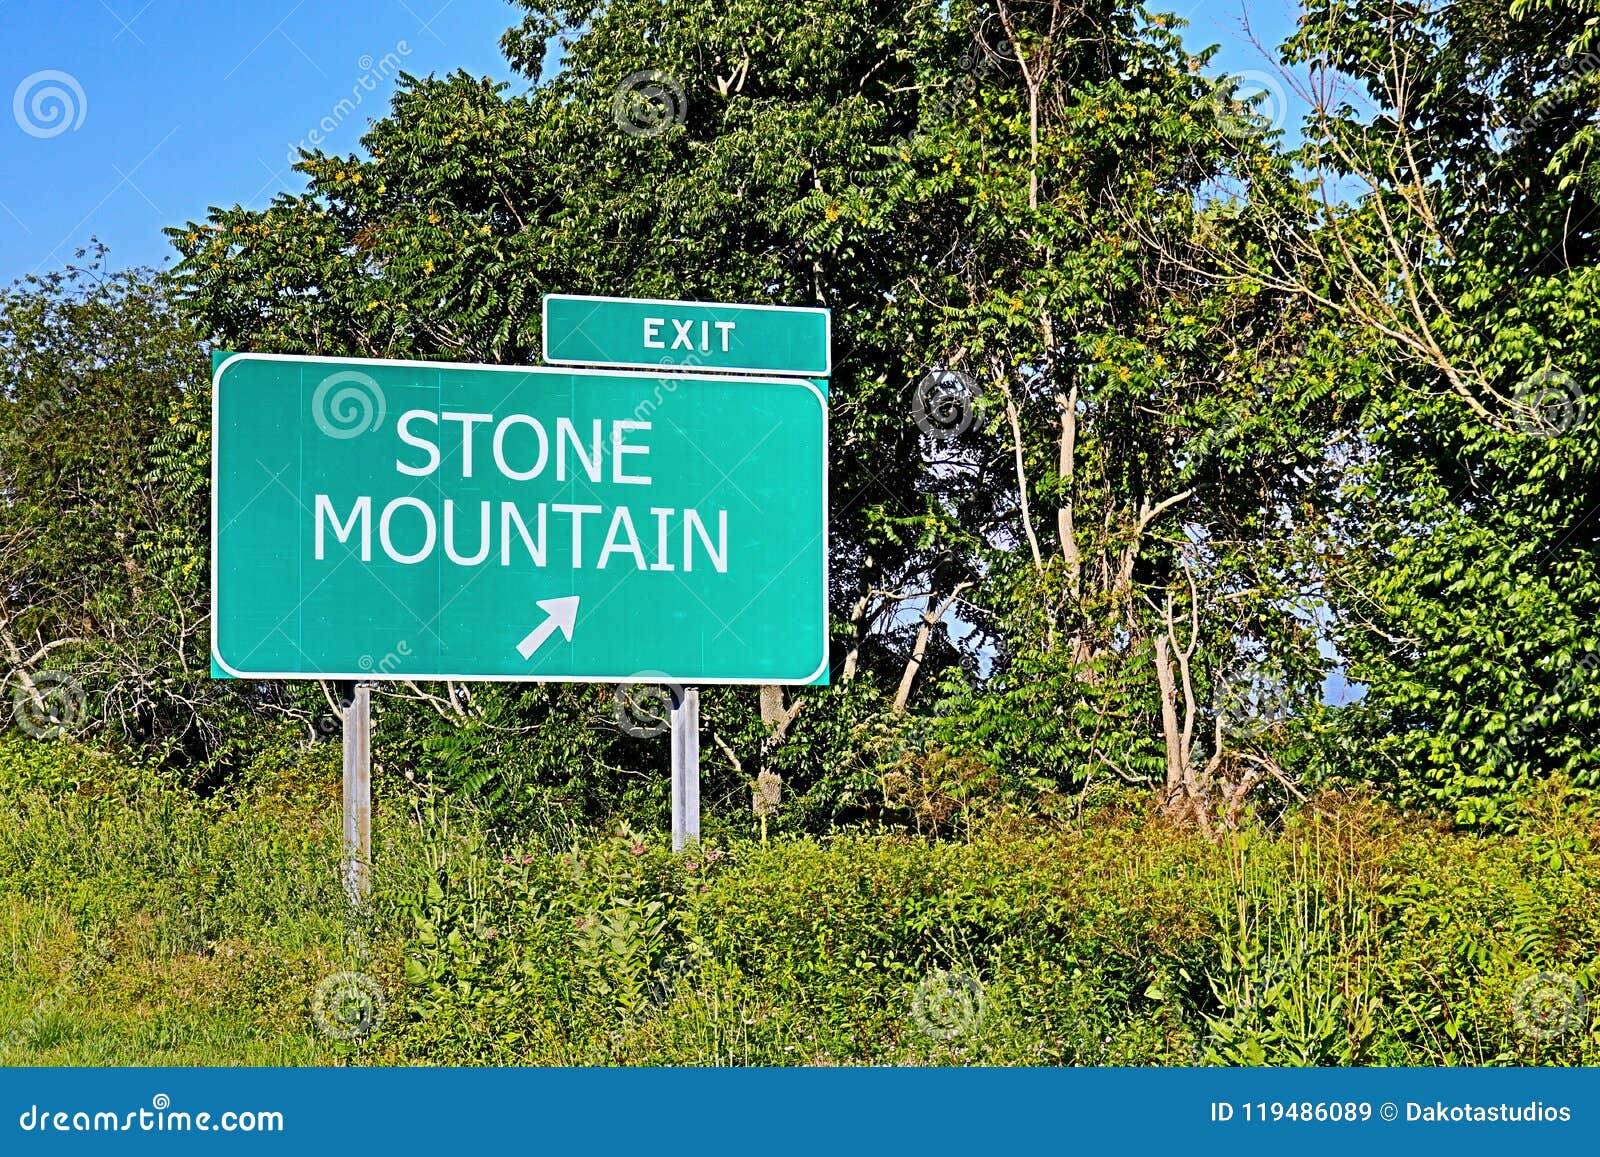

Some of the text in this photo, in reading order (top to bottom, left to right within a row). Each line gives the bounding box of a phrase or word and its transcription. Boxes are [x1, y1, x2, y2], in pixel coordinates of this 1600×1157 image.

[643, 317, 736, 352] EXIT
[395, 408, 653, 486] STONE
[314, 493, 728, 574] MOUNTAIN
